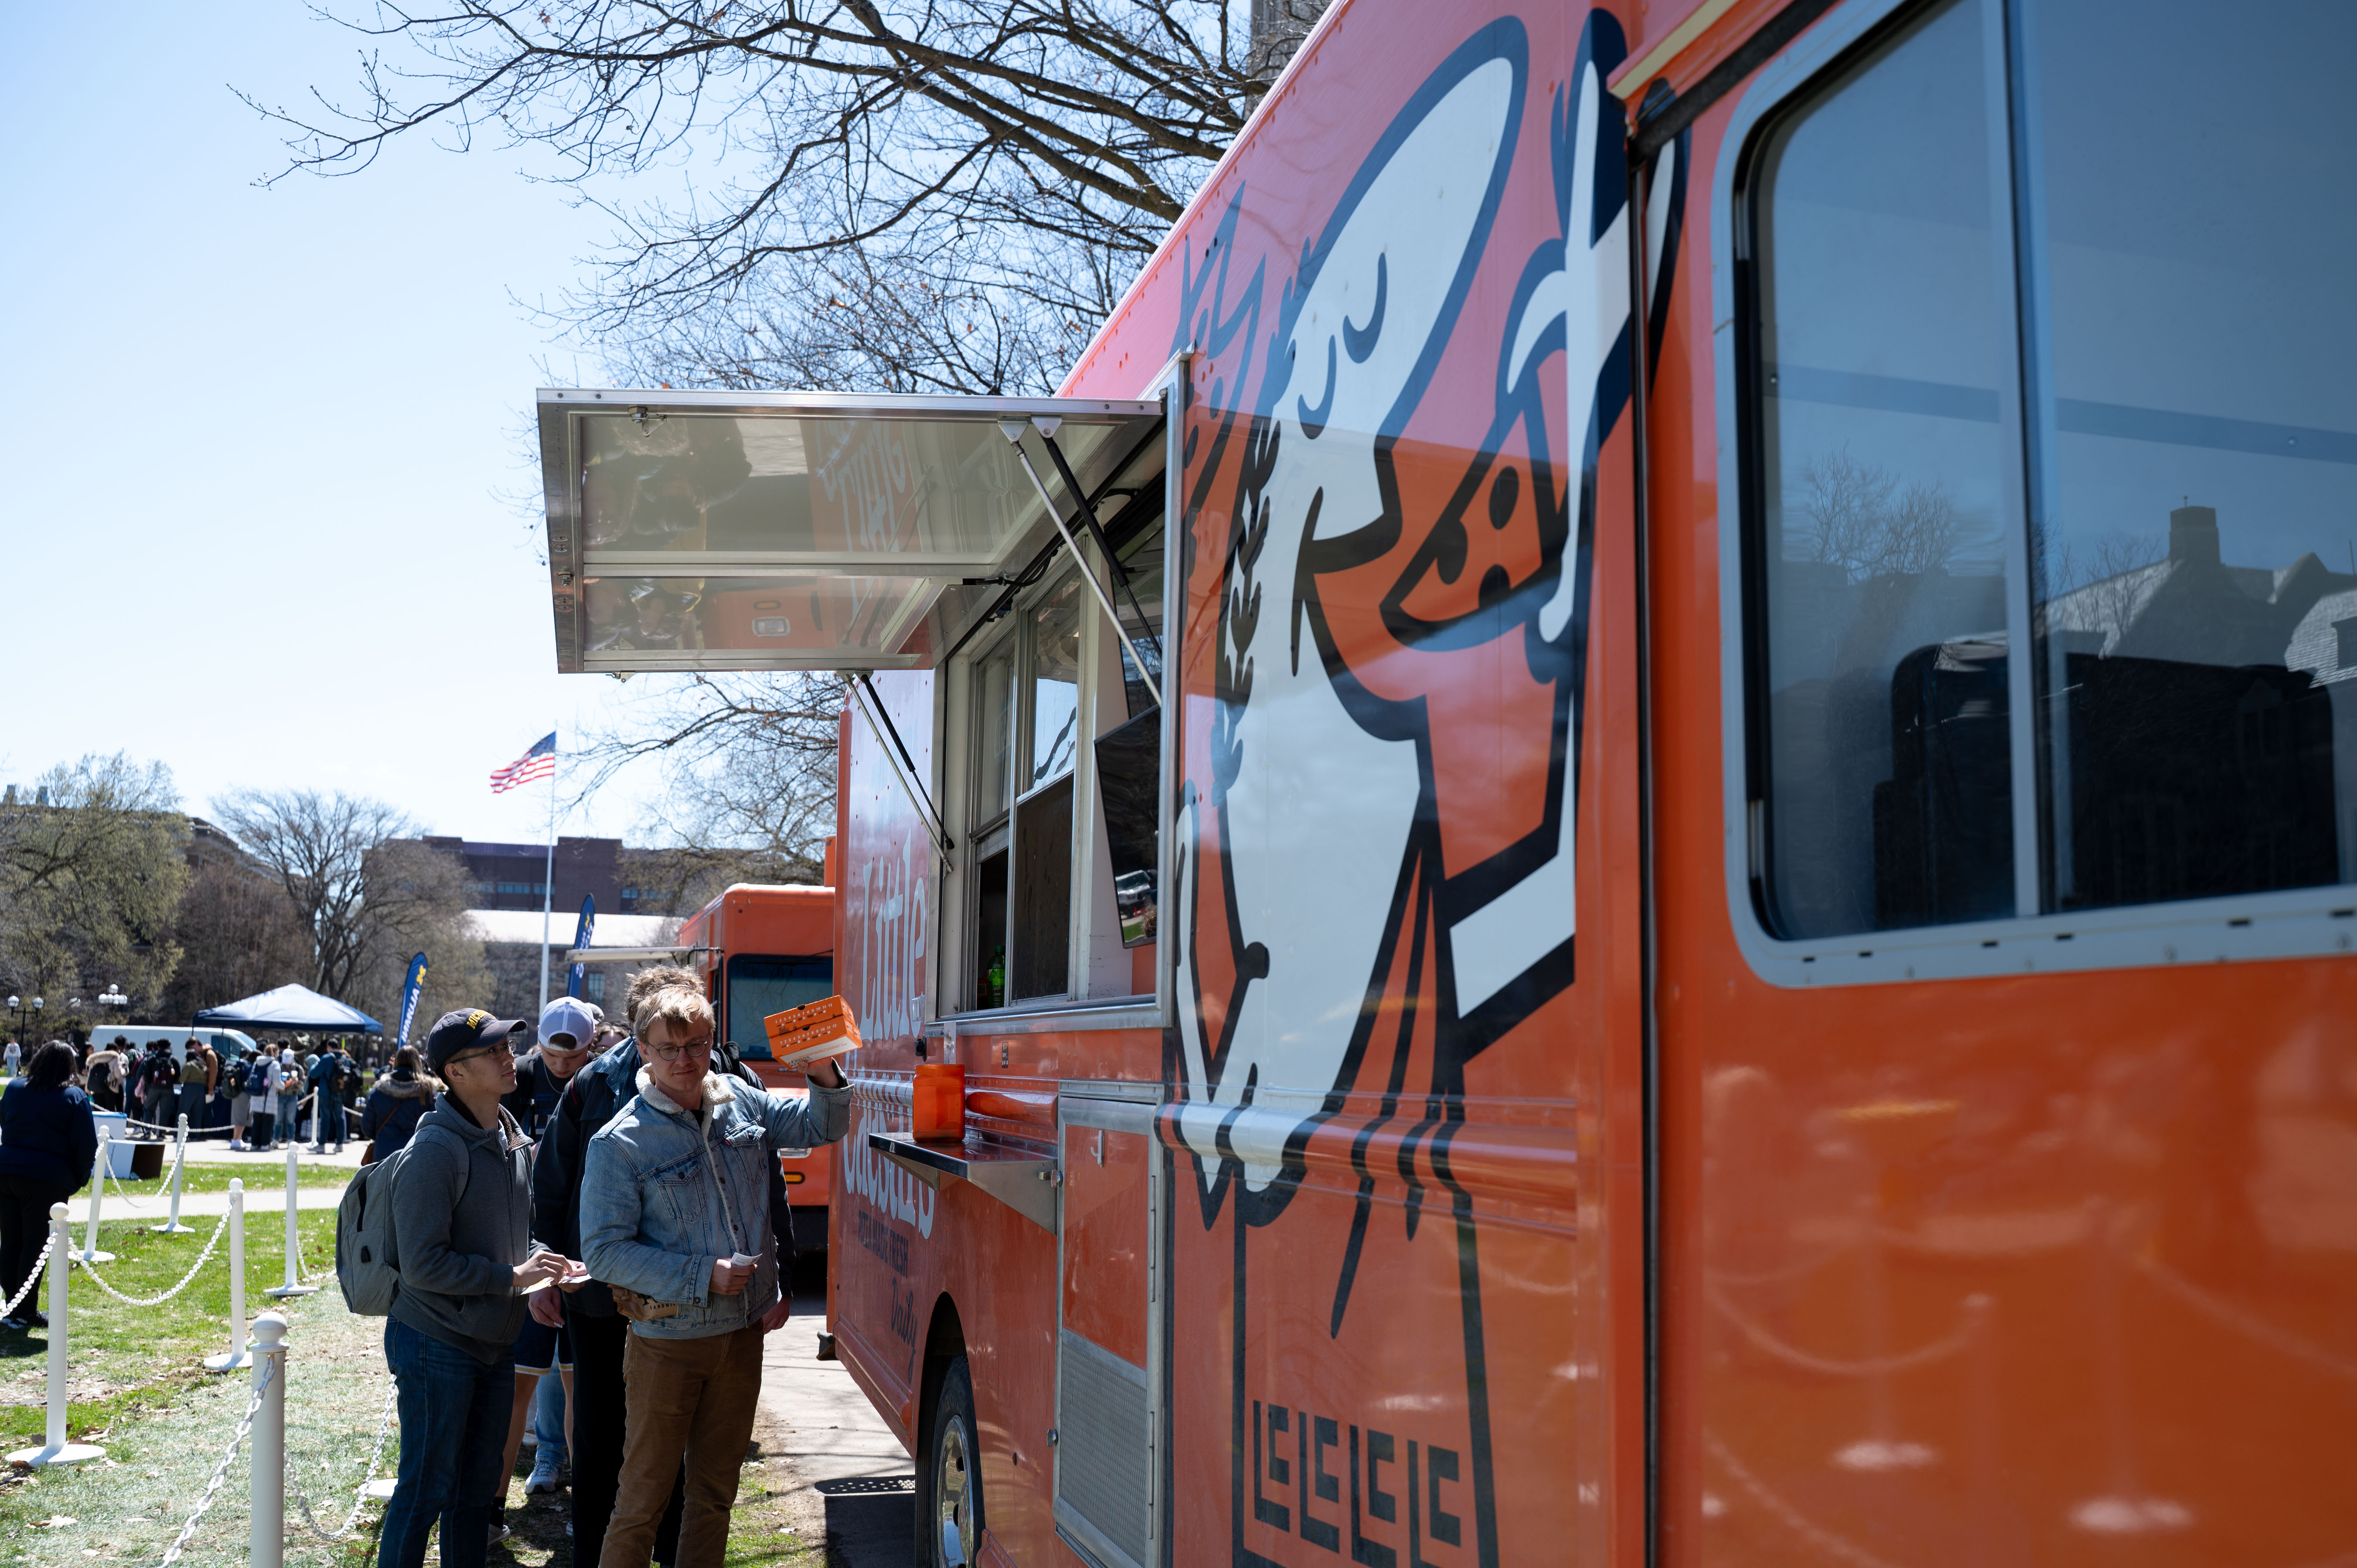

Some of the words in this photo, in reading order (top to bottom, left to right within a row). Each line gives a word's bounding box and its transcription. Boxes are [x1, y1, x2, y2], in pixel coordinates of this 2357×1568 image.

[859, 828, 925, 1043] Little
[873, 1219, 888, 1264] MADE
[889, 1228, 909, 1279] FRESH
[891, 1276, 917, 1385] Daily
